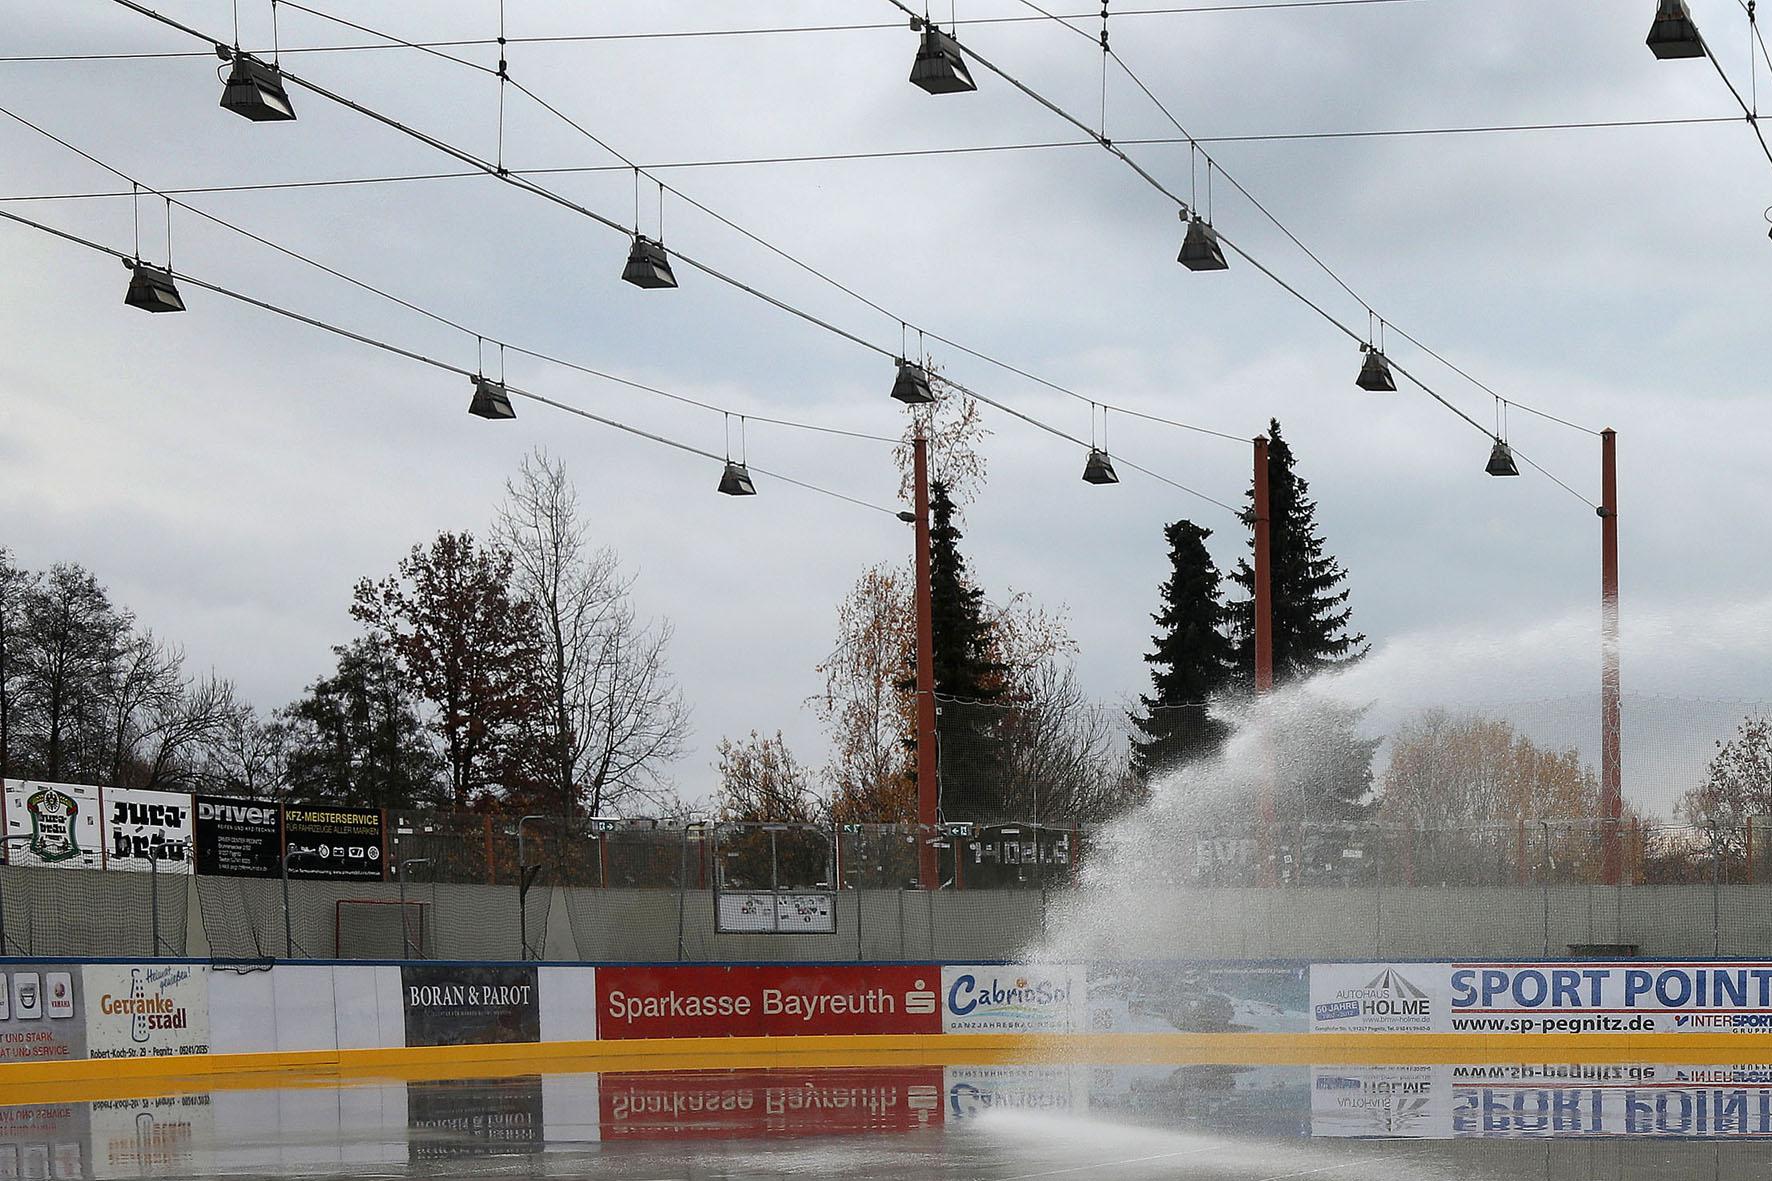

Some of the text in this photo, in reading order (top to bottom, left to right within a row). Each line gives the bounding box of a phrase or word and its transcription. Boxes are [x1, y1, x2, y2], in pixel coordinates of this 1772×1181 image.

[285, 810, 379, 825] KFZ-MEISTERSERVICE
[286, 823, 379, 836] FÜR FAHRZEUGE ALLER MARKEN
[409, 985, 530, 1006] BORAN & PAROT
[1336, 990, 1390, 999] AUTOHAUS
[1450, 969, 1610, 1008] SPORT
[101, 992, 174, 1015] Getränke
[609, 990, 751, 1023] Sparkasse
[762, 988, 895, 1020] Bayreuth
[1328, 1002, 1358, 1012] JAHRE
[1362, 1000, 1430, 1015] HOLME
[148, 1008, 187, 1030] stadl
[1452, 1015, 1655, 1034] www.sp-pegnitz.de
[5, 1033, 24, 1043] UND
[14, 1048, 31, 1057] UND
[90, 1047, 138, 1059] Robert-Koch-Str.
[152, 1046, 173, 1057] Pegnitz
